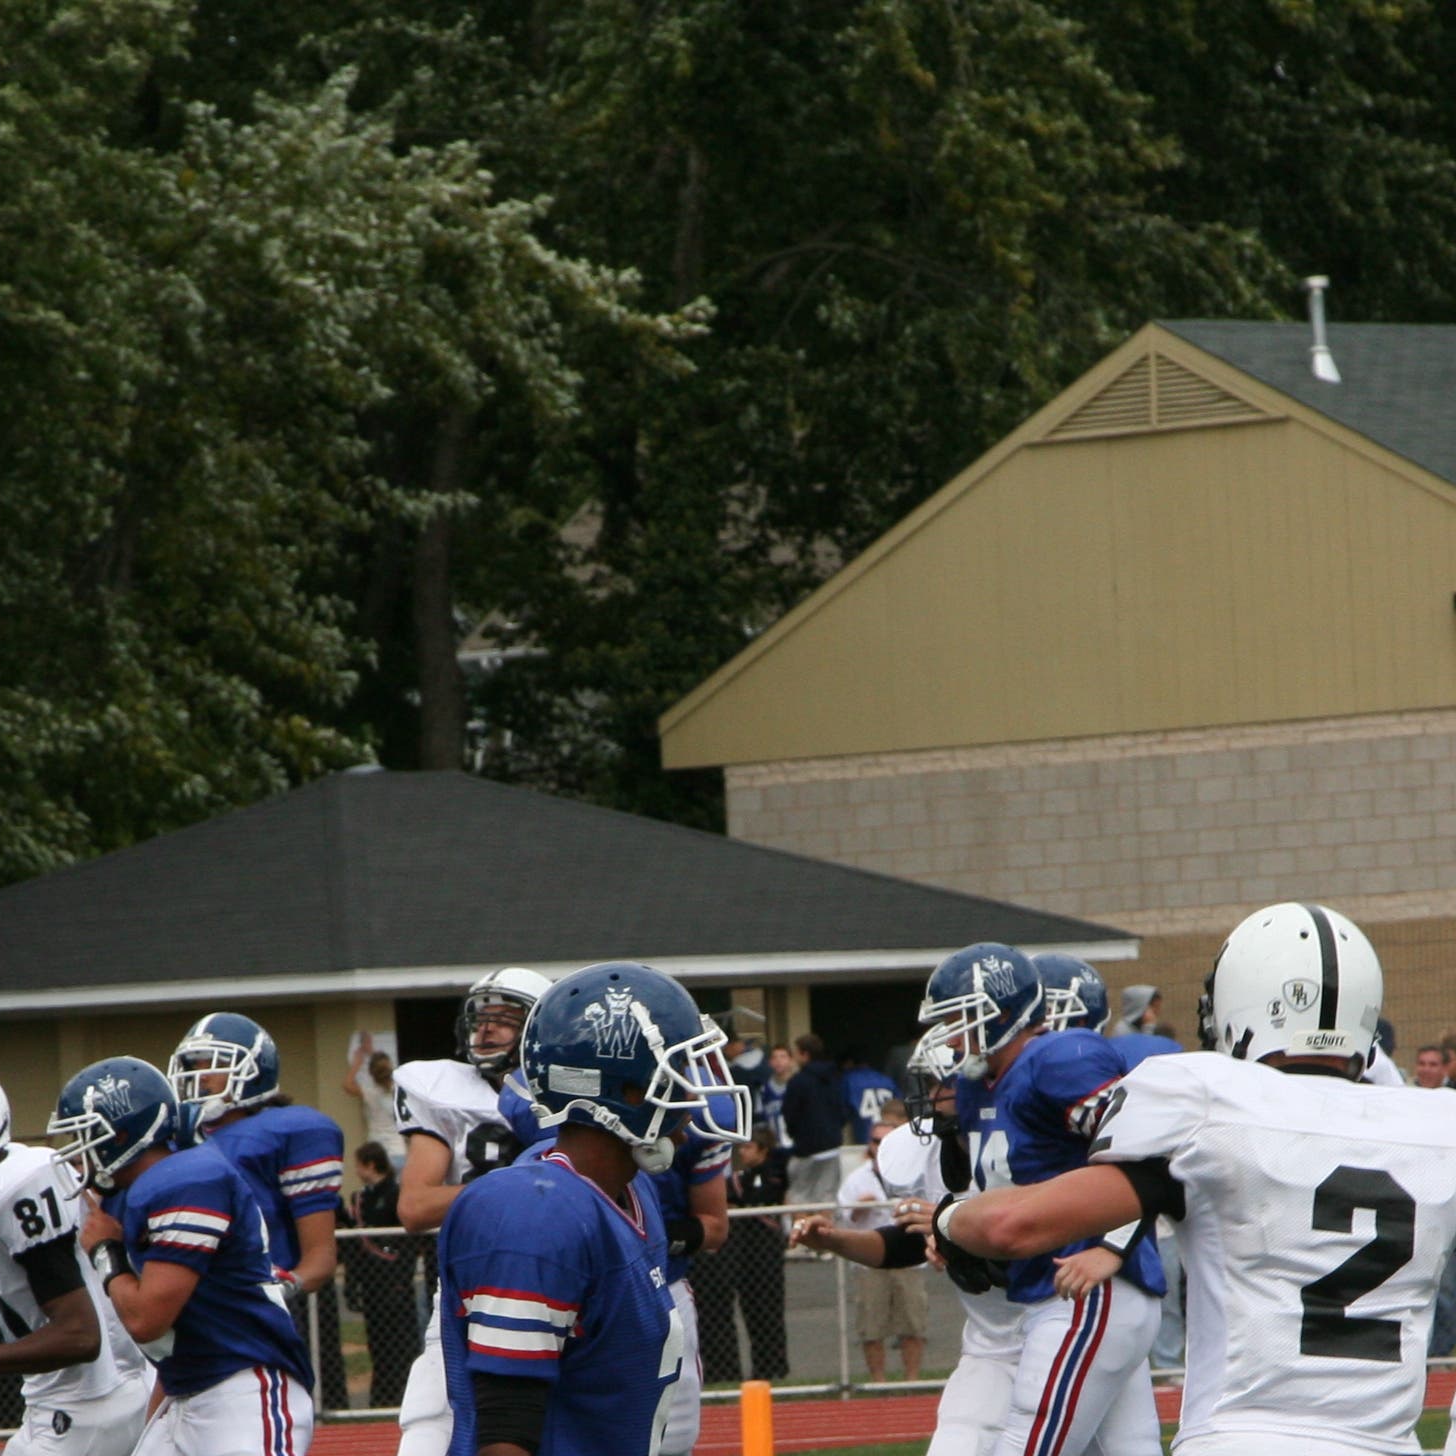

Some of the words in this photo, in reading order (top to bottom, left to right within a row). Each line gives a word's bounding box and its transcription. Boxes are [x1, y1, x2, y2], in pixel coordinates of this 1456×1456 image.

[594, 1014, 641, 1060] W
[13, 1187, 62, 1239] 81
[1300, 1165, 1416, 1363] 2
